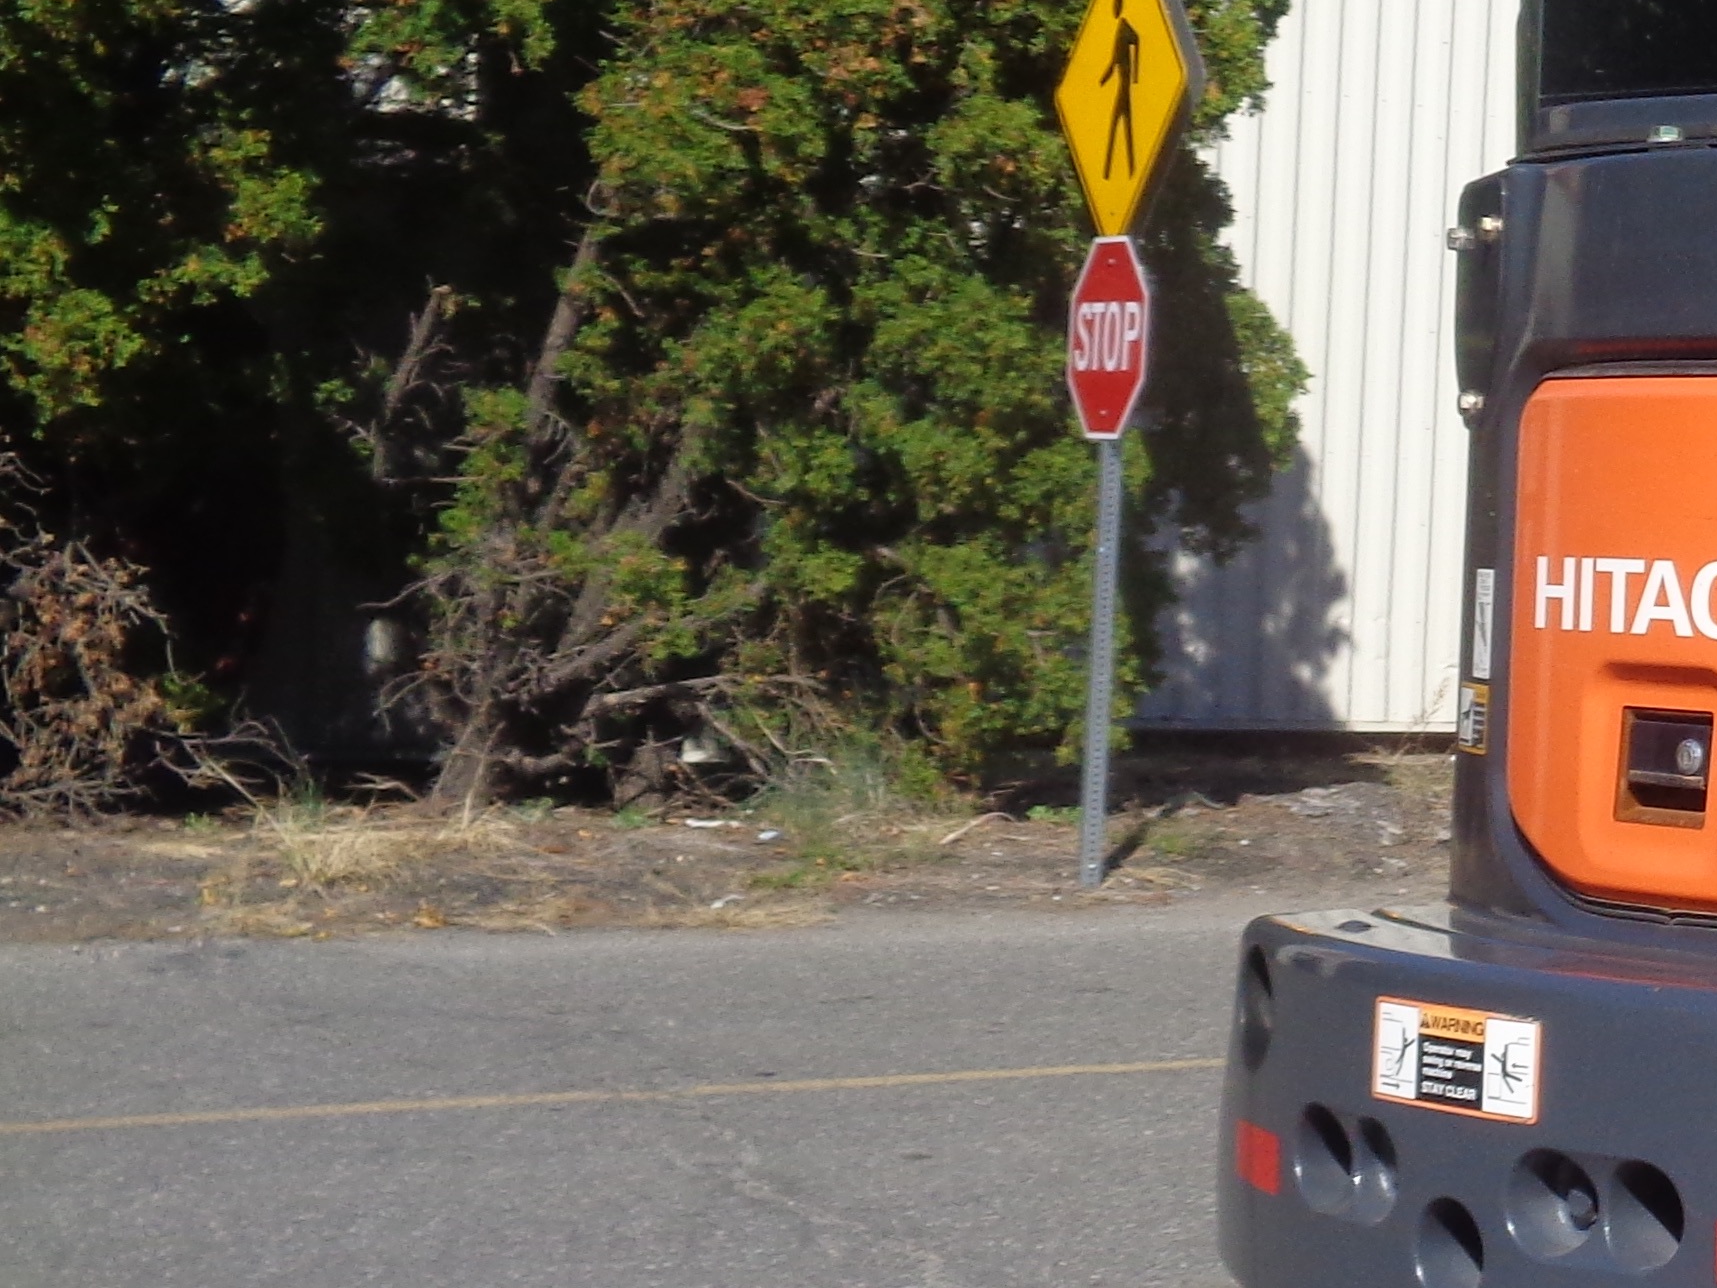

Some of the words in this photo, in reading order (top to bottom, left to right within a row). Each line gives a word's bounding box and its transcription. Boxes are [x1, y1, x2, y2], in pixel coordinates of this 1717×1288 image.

[1074, 302, 1140, 371] STOP
[1431, 1015, 1485, 1036] WARNING
[1421, 1080, 1445, 1096] STAY
[1445, 1084, 1478, 1101] CLEAR
